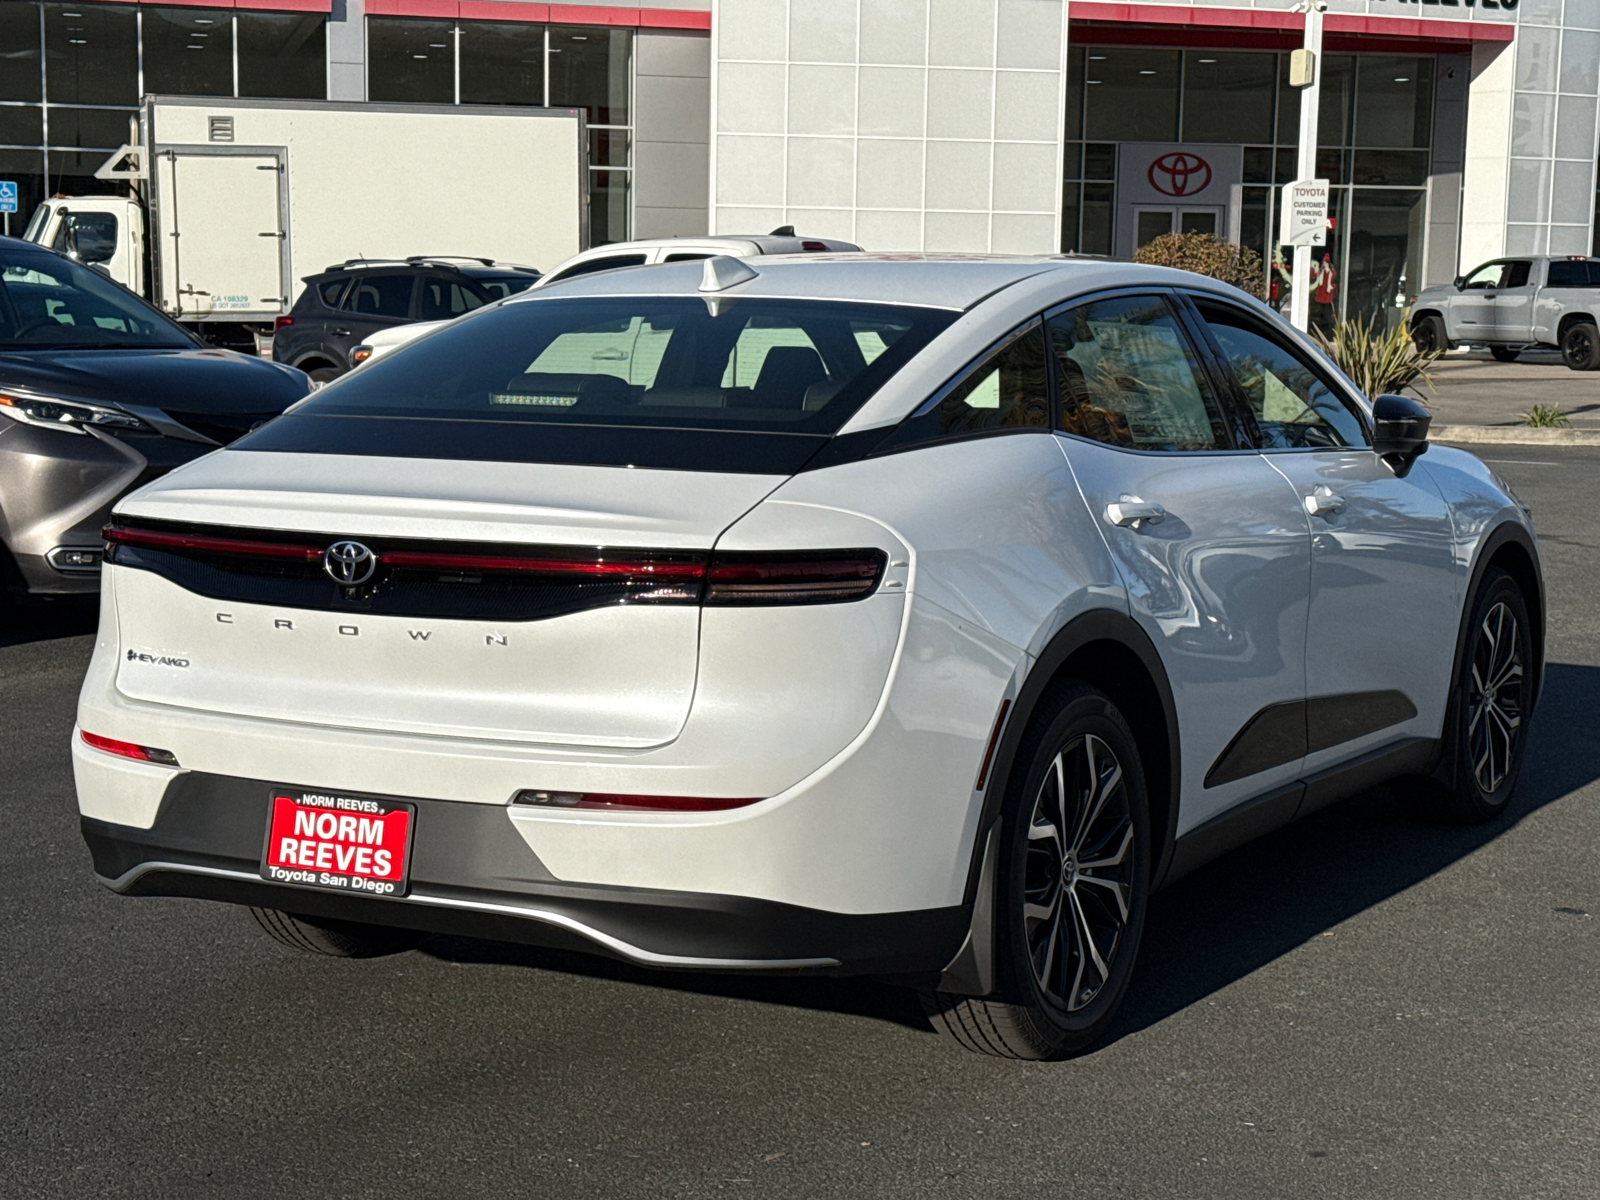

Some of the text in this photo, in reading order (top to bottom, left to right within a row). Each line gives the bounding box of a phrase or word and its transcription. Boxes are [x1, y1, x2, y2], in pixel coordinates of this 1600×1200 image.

[1295, 188, 1326, 197] TOYOTA
[216, 612, 508, 646] CROWN
[302, 793, 379, 813] NORM REEVES
[293, 810, 385, 846] NORM
[279, 837, 392, 876] REEVES
[269, 865, 395, 894] Toyota San Diego
